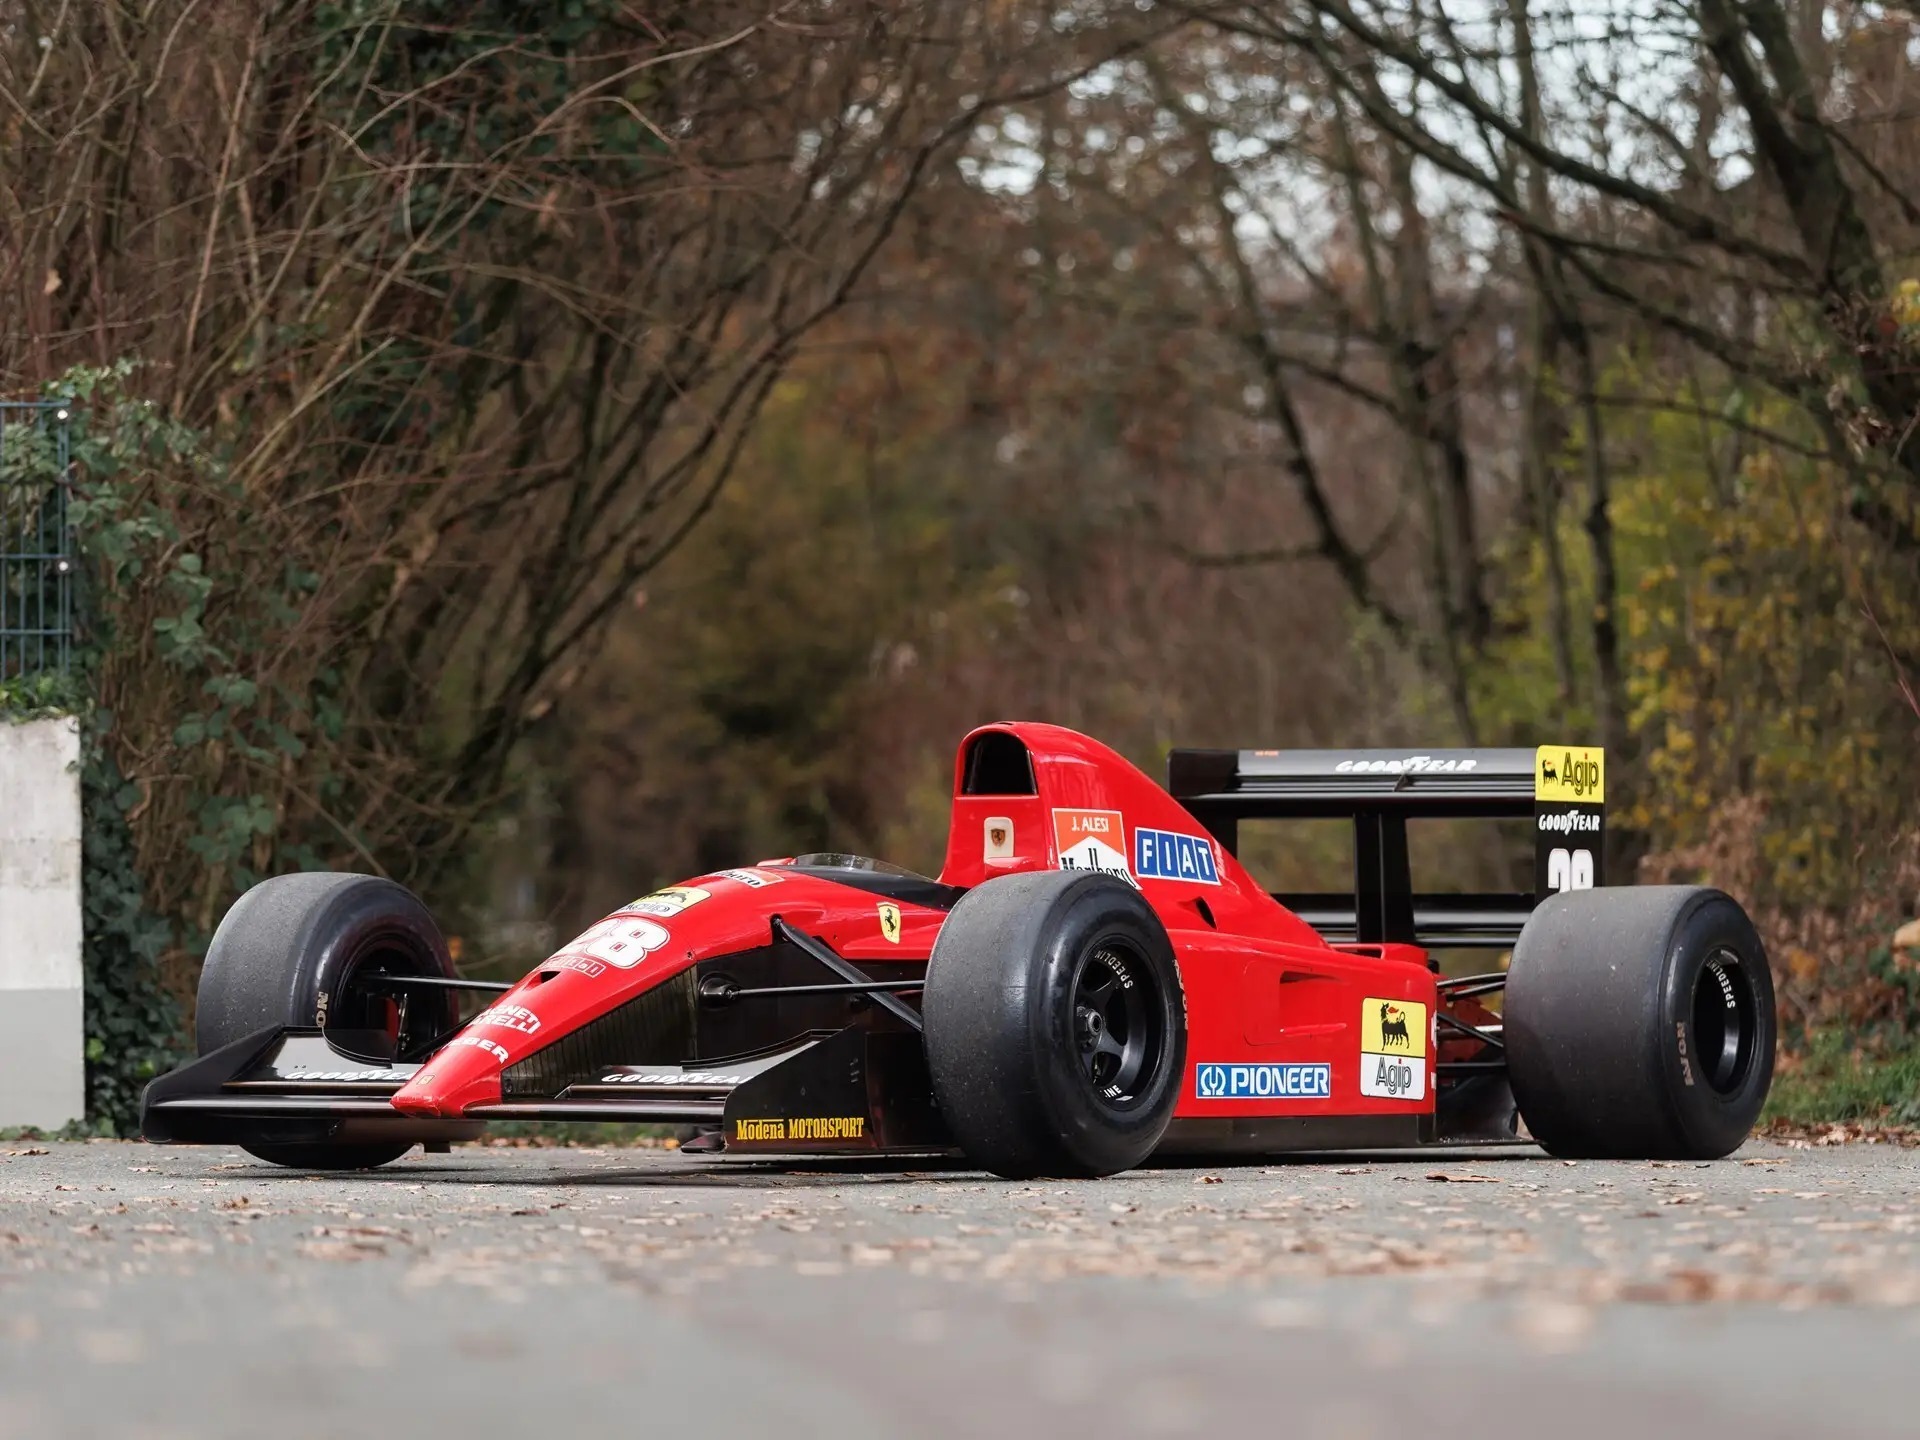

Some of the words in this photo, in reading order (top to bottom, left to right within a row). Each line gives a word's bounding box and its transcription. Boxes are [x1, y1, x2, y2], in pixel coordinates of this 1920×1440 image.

[1335, 756, 1477, 773] GOODYEAR
[1561, 752, 1599, 796] Agip
[1071, 817, 1080, 832] J.
[1081, 817, 1109, 833] ALESI
[1538, 809, 1600, 836] GOODYEAR
[1142, 838, 1210, 876] FIAT
[1094, 950, 1134, 989] SPEEDLIN
[1231, 1067, 1329, 1094] PIONEER
[1376, 1056, 1412, 1095] Agip
[737, 1119, 784, 1140] Modena
[788, 1117, 864, 1139] MOTORSPORT
